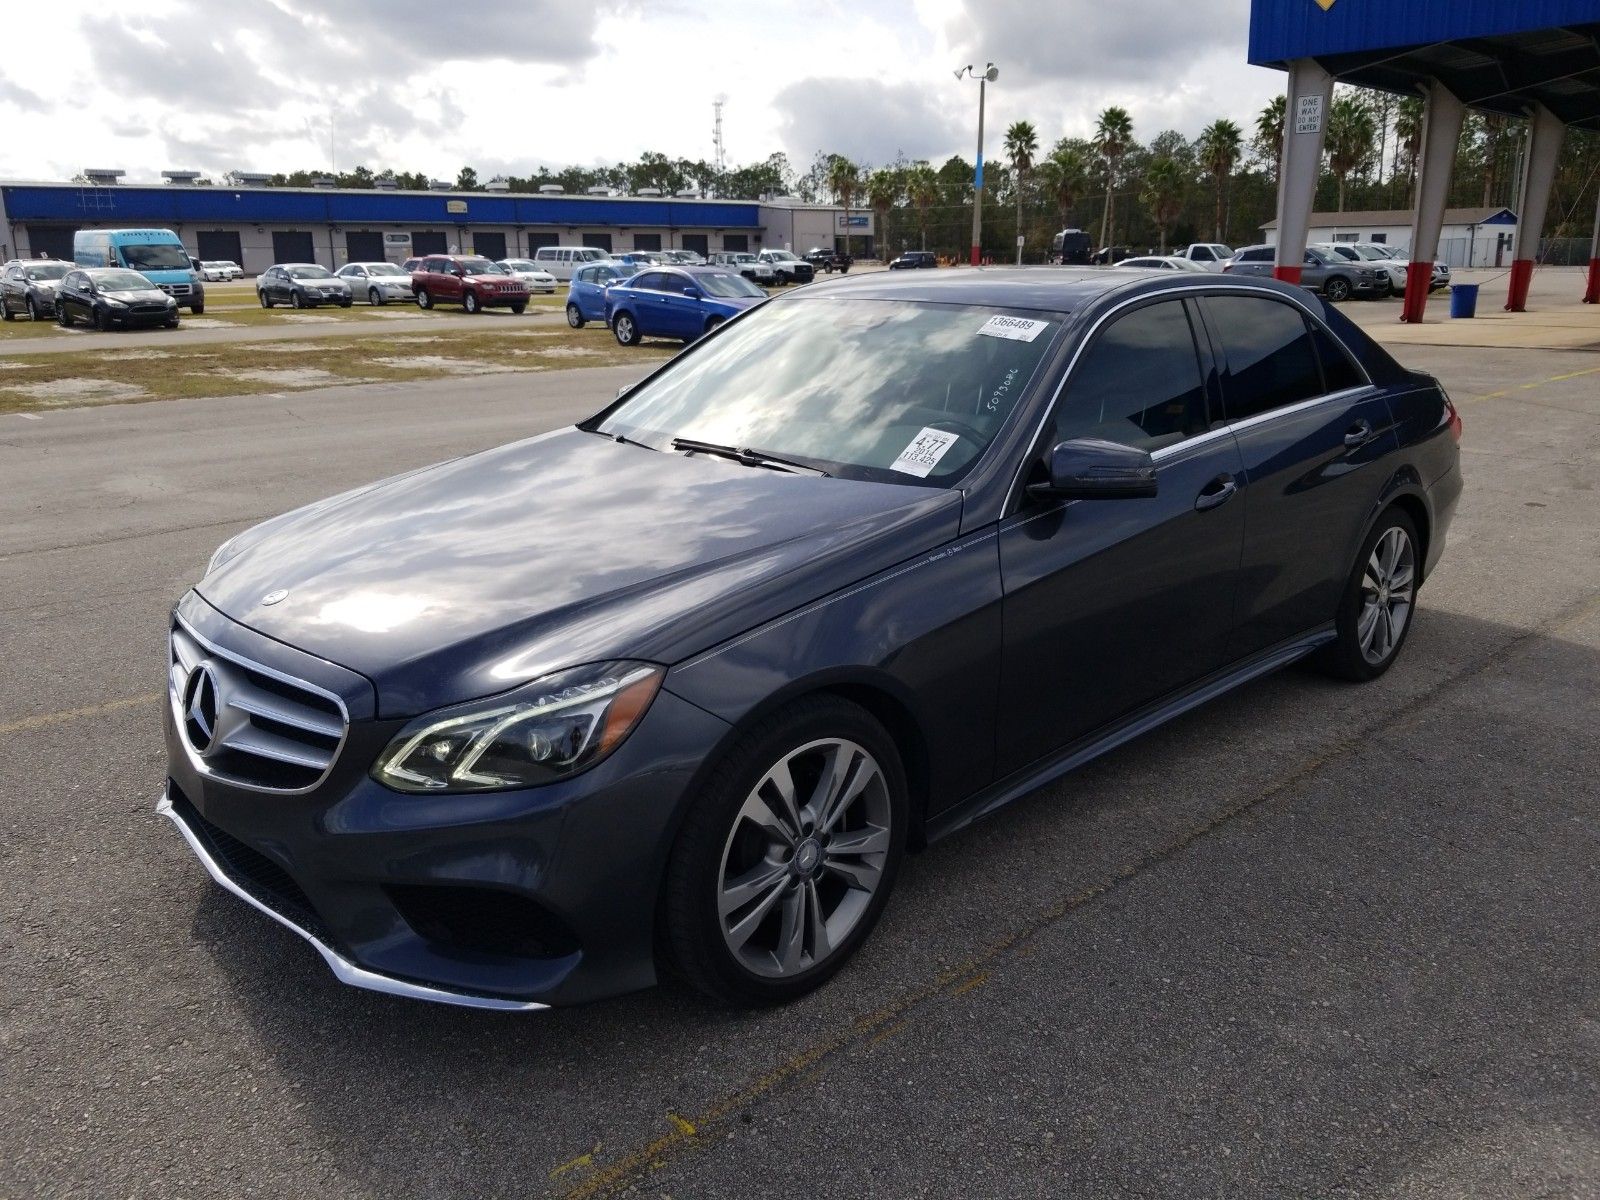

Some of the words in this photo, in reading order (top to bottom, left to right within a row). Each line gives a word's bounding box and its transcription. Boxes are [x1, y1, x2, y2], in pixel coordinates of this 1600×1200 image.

[1303, 98, 1318, 106] ONE
[1302, 107, 1318, 115] WAY
[1299, 124, 1317, 132] ENTER
[990, 317, 1035, 330] 1366489
